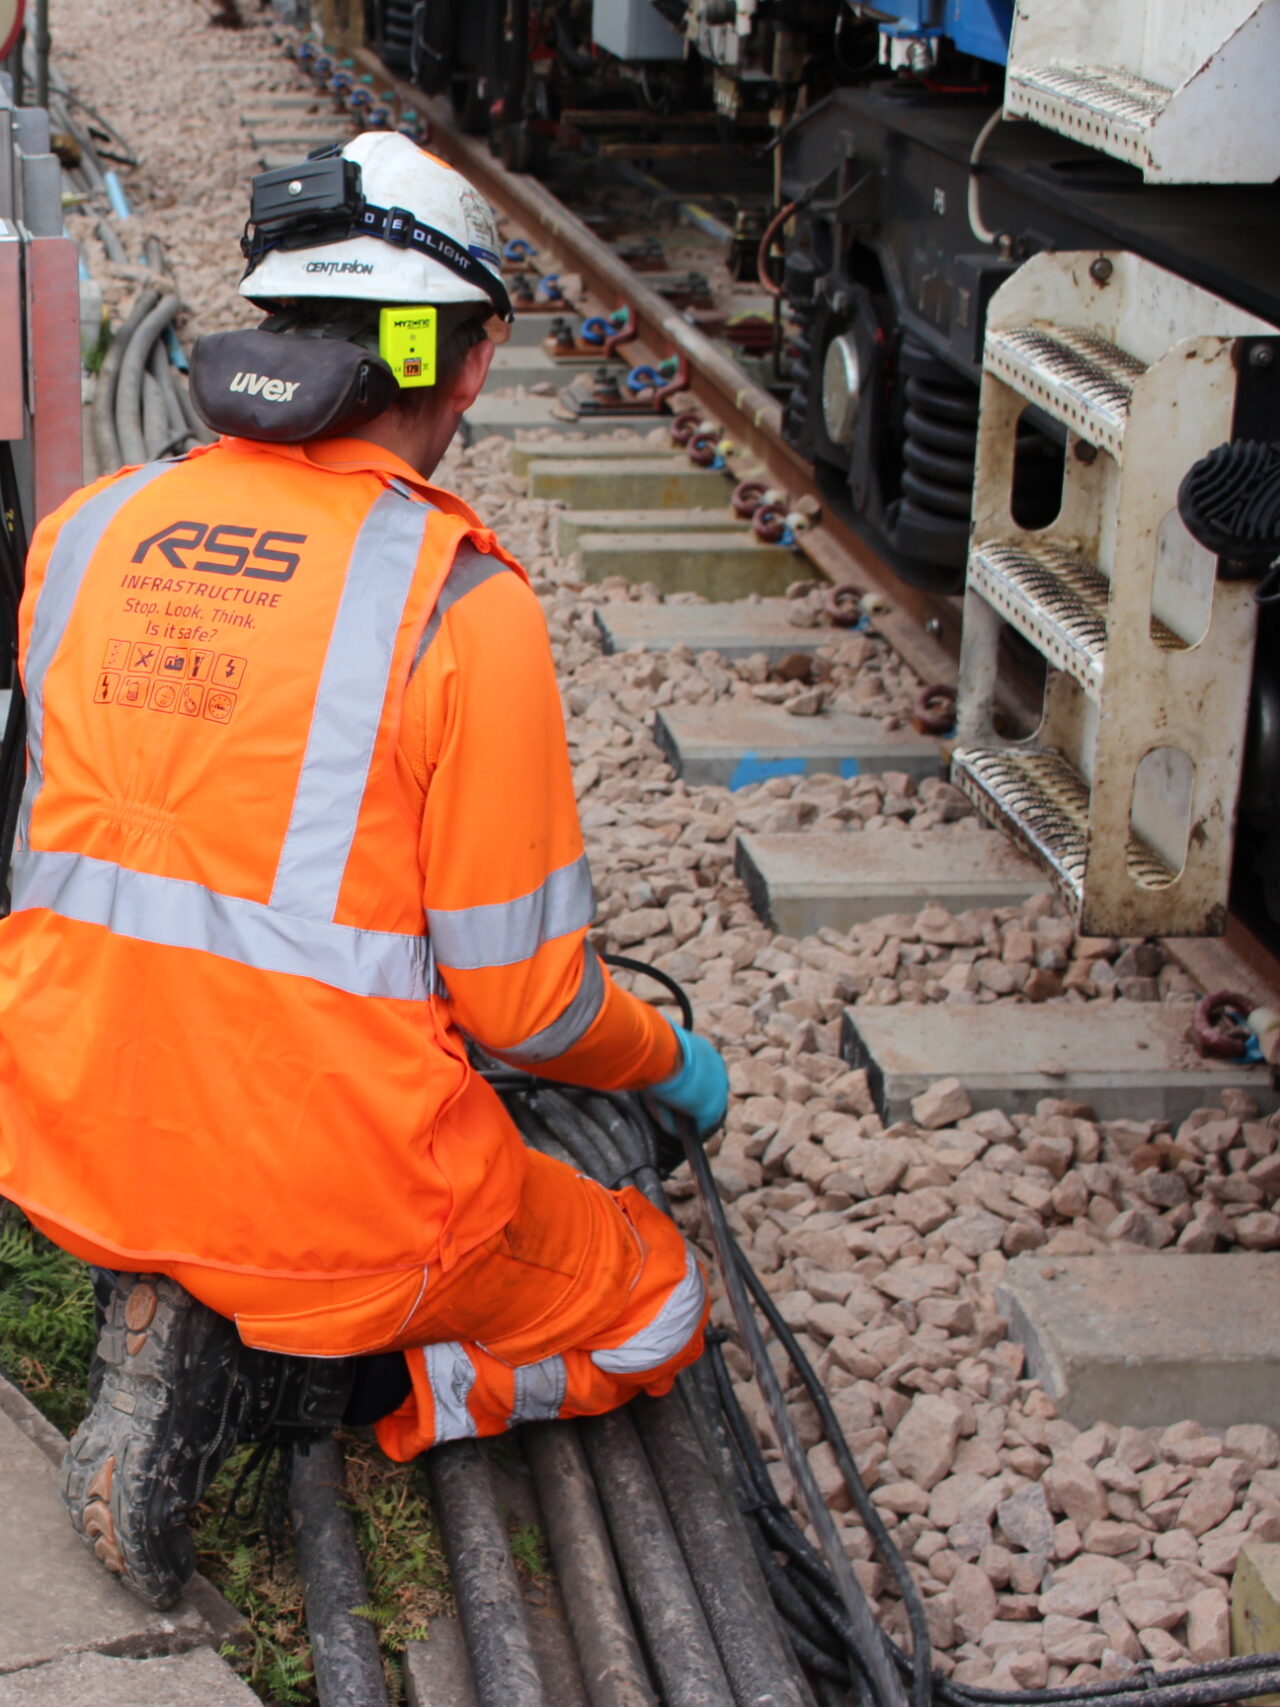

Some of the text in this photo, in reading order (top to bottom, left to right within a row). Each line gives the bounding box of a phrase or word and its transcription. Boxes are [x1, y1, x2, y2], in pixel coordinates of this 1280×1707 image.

[306, 259, 374, 276] CENTURION
[229, 372, 301, 402] uvex
[131, 520, 308, 583] RSS
[120, 574, 282, 608] INFRASTRUCTURE
[123, 597, 256, 629] Stop. Look. Think.
[145, 620, 218, 642] Is it safe?
